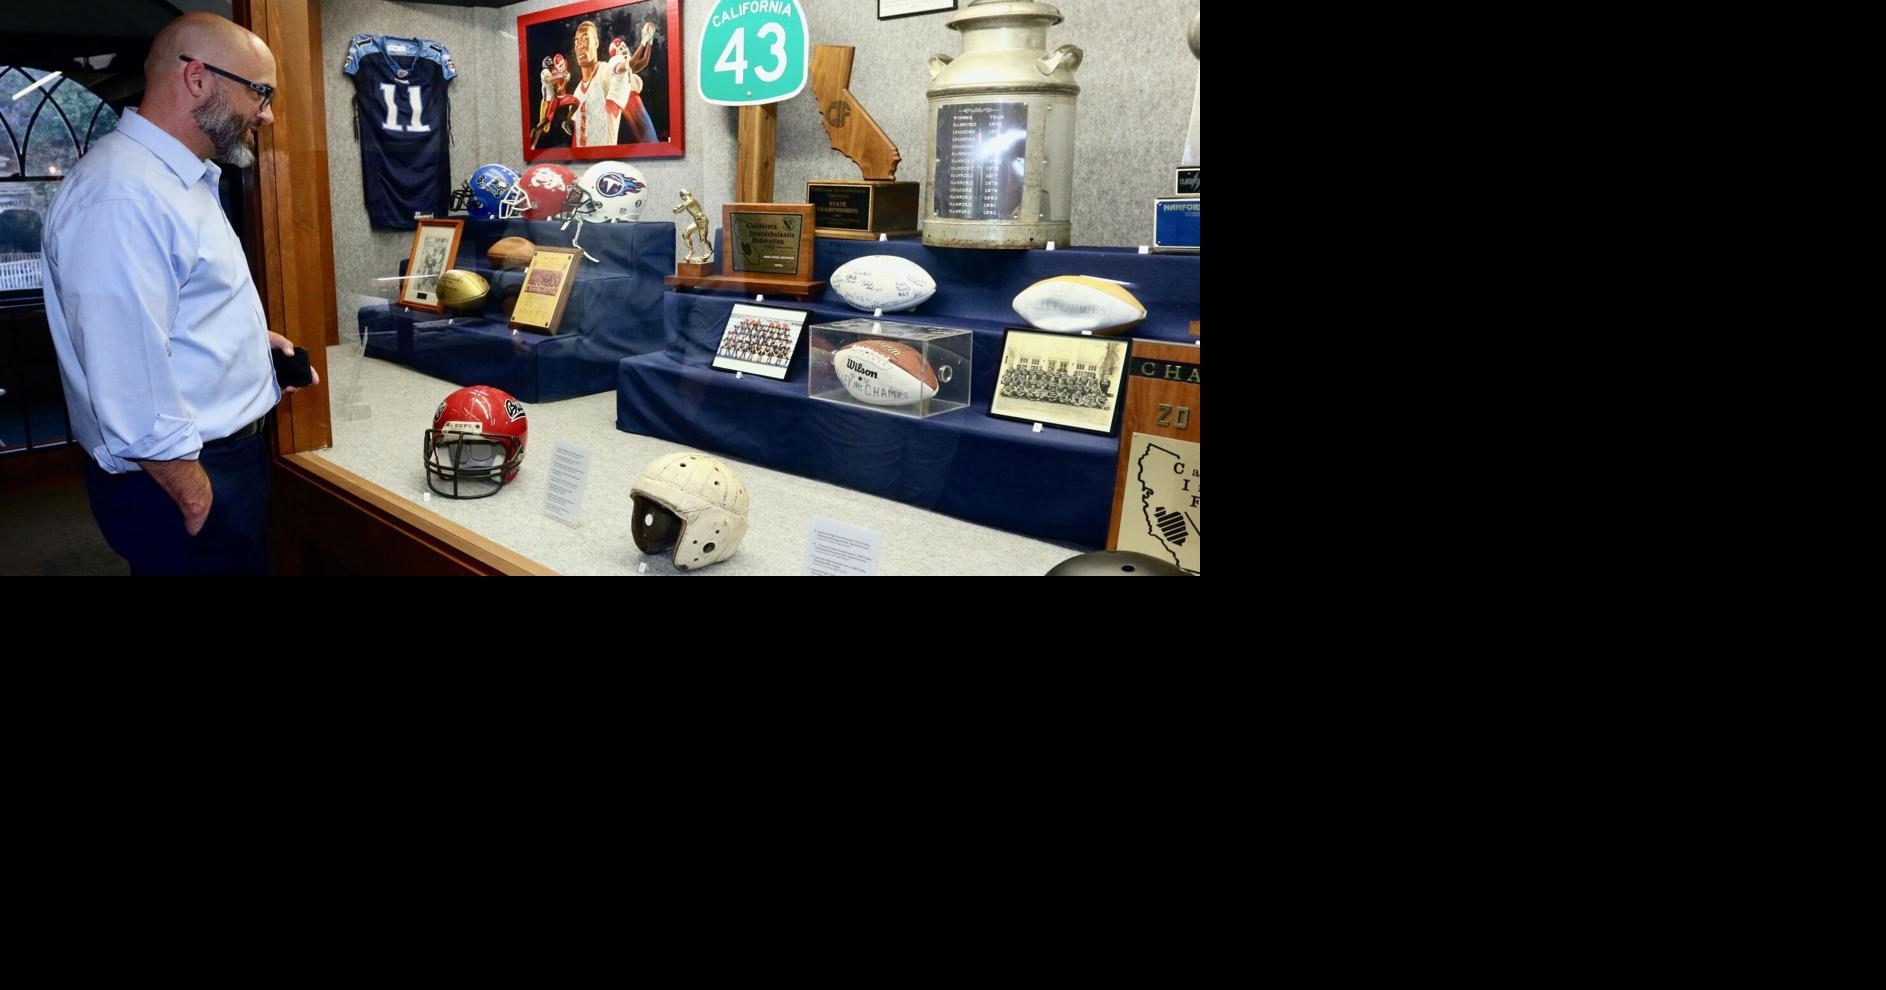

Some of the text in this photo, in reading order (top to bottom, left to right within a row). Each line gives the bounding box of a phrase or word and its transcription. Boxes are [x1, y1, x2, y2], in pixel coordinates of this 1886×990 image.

[712, 0, 792, 27] CALIFORNIA
[714, 22, 788, 85] 43
[380, 83, 431, 132] 11
[749, 230, 795, 238] Interscholastic
[752, 237, 785, 245] Federation
[846, 358, 879, 379] Wilson
[864, 384, 910, 399] CHAMPS
